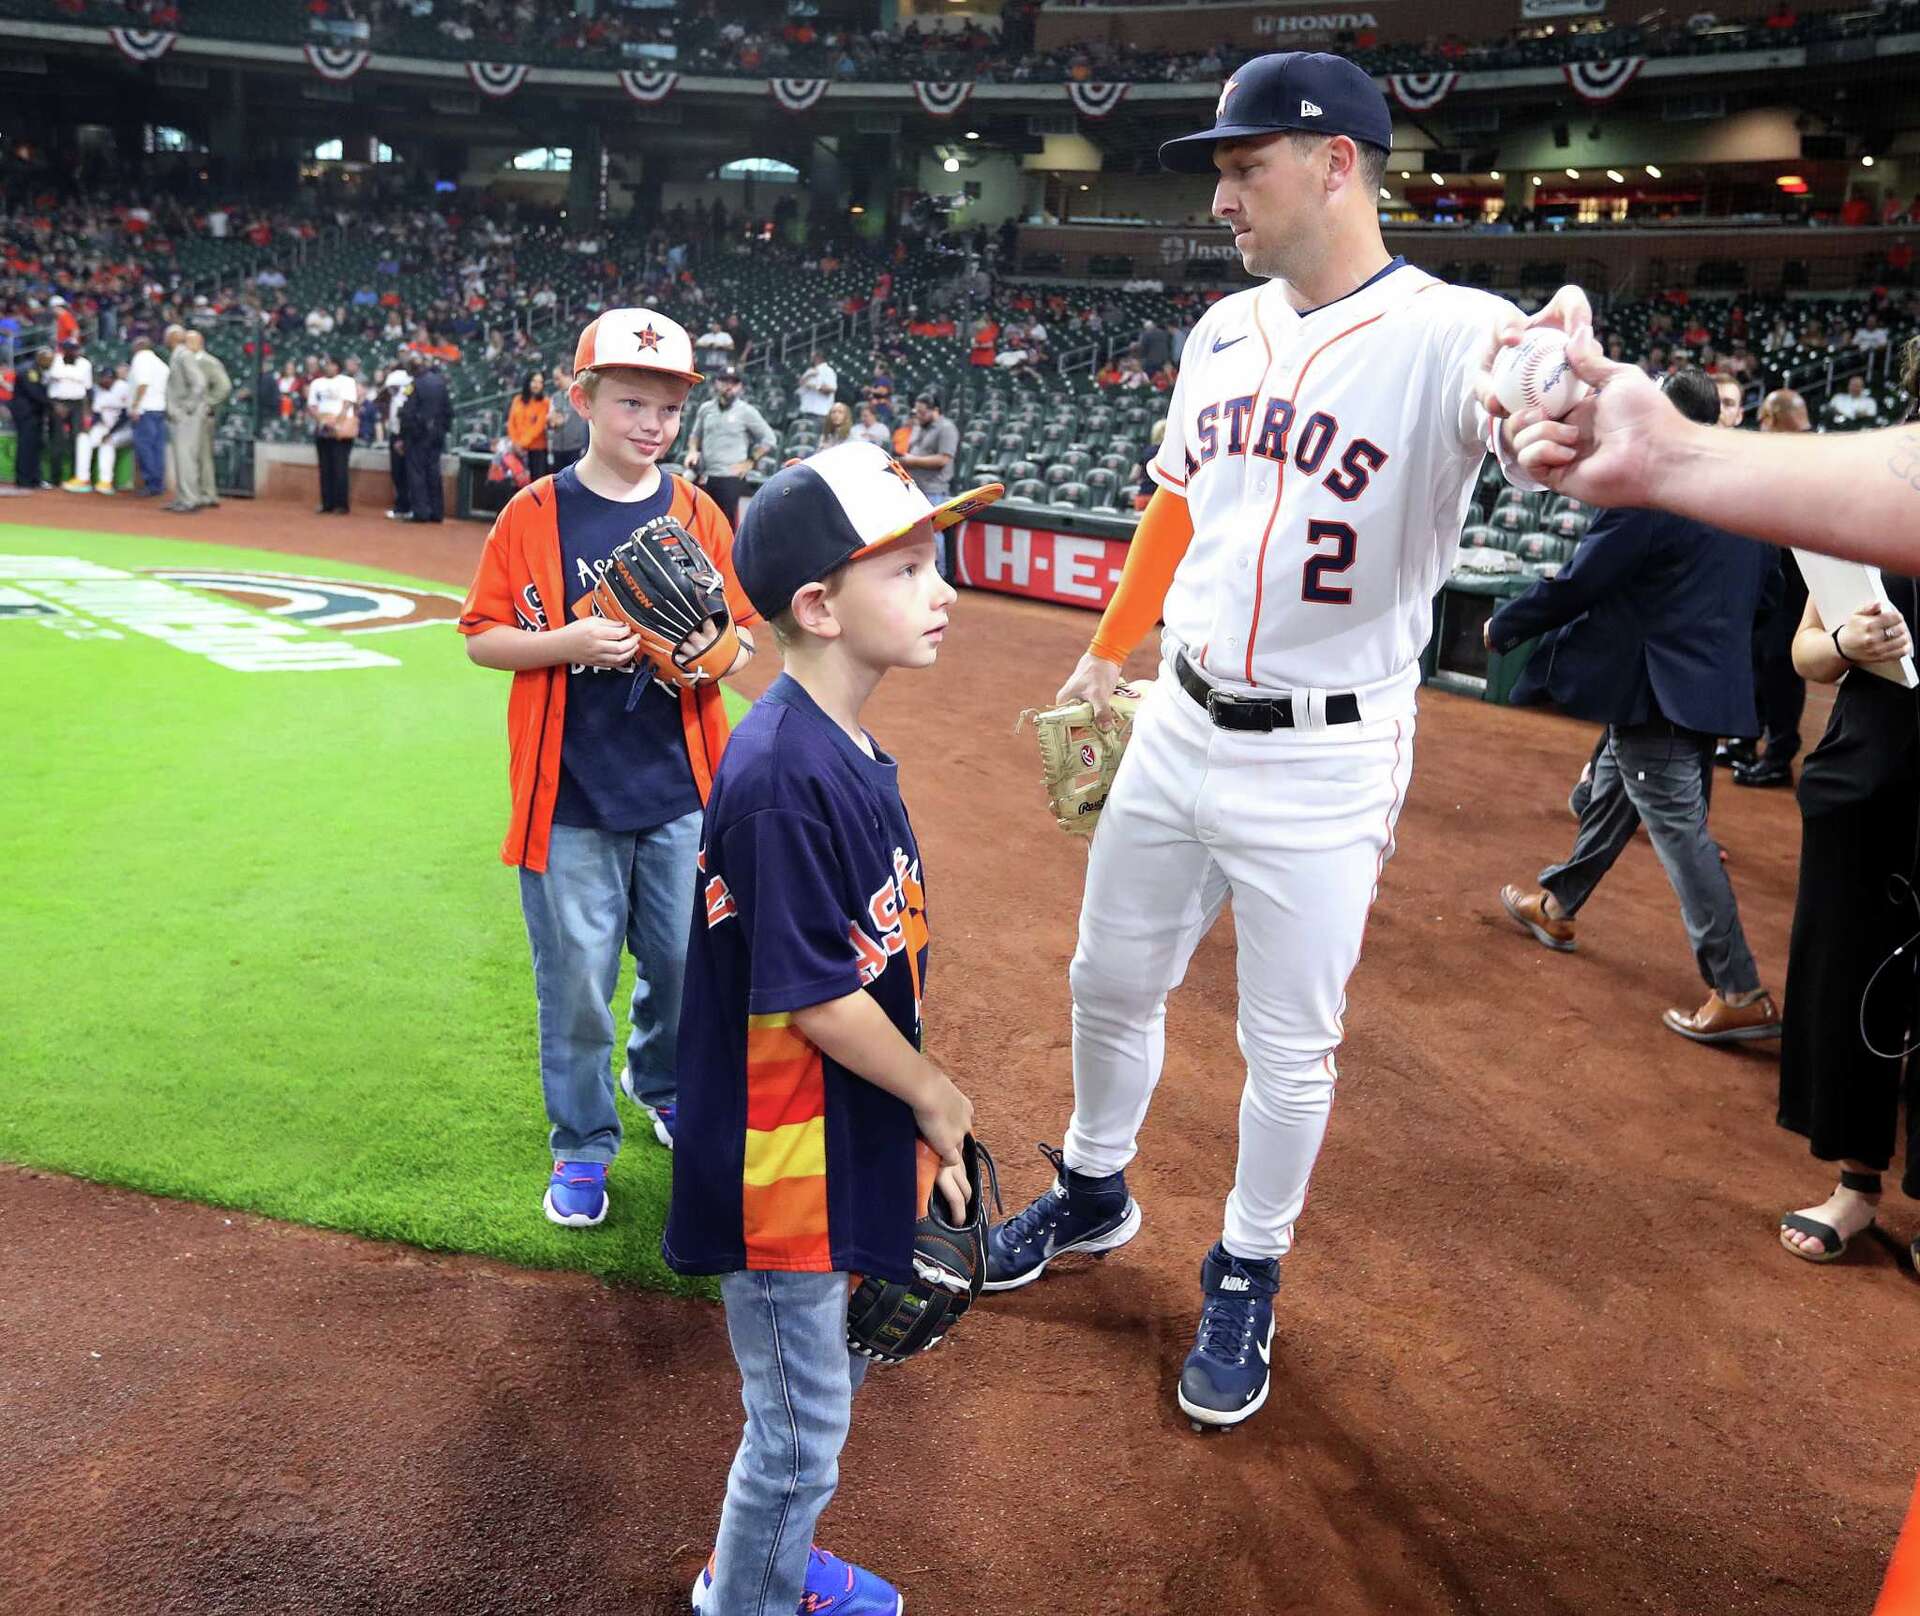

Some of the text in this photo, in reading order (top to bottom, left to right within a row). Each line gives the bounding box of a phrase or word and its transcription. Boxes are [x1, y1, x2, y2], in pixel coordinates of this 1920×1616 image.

[1278, 13, 1378, 32] HONDA
[1187, 239, 1242, 262] Insp
[983, 523, 1120, 600] H-E-
[1301, 518, 1357, 605] 2
[1220, 1274, 1250, 1291] NIKE
